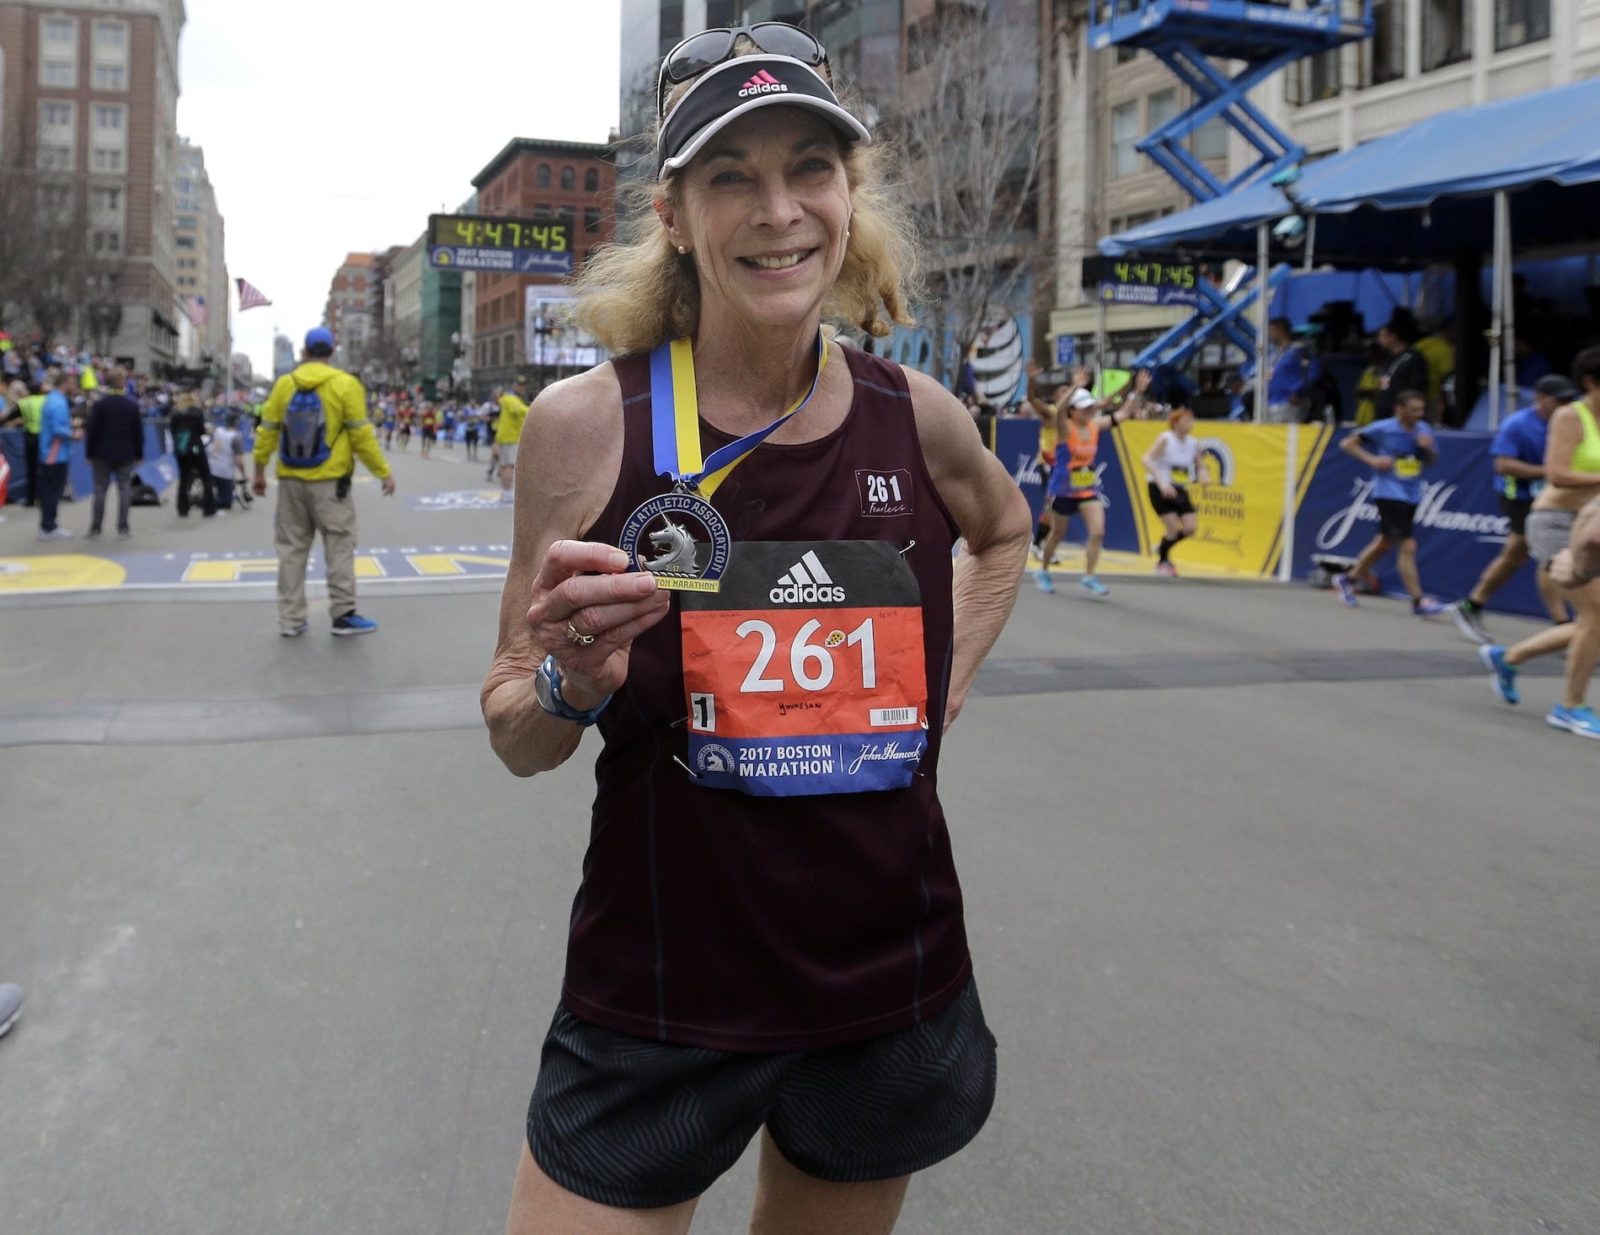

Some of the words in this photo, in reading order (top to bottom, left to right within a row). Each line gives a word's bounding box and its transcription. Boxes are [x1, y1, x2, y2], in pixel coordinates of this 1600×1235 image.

[738, 83, 788, 98] adidas
[457, 221, 566, 252] 4:47:45
[1114, 262, 1194, 288] 4:47:45
[867, 474, 902, 503] 261
[869, 502, 907, 514] Fearless
[1413, 479, 1512, 541] Hancoc
[637, 497, 691, 523] ATHLETIC
[691, 501, 726, 573] ASSOCIATION
[655, 579, 673, 589] TON
[673, 580, 715, 591] MARATHON
[769, 583, 846, 604] adidas
[736, 617, 876, 693] 261
[694, 697, 708, 728] 1
[739, 746, 771, 761] 2017
[777, 744, 832, 760] BOSTON
[848, 743, 882, 775] John
[880, 741, 922, 763] Hancock
[740, 760, 834, 777] MARATHON
